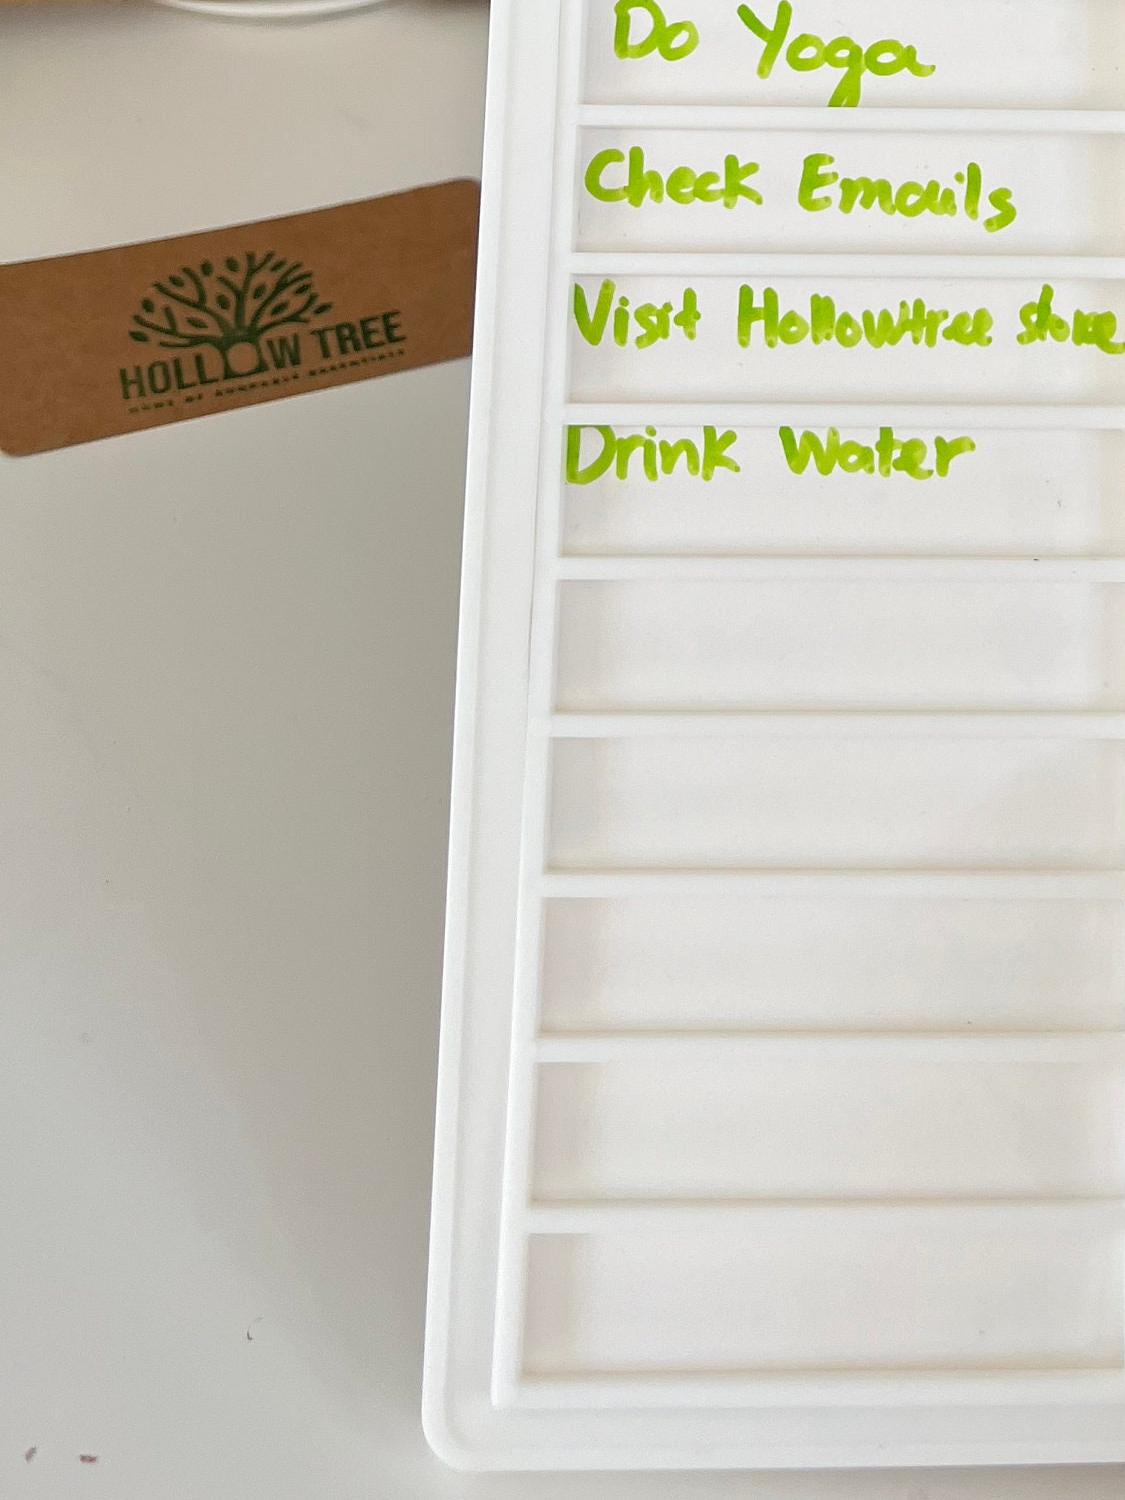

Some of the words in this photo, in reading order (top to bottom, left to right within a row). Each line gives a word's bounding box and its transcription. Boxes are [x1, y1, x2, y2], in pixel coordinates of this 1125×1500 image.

[737, 1, 935, 108] Yoga
[585, 147, 762, 209] Check
[798, 154, 1016, 232] Emails
[309, 309, 407, 360] TREE
[573, 280, 701, 349] Visit
[738, 285, 992, 348] Hollowtree
[566, 425, 740, 485] Drink
[779, 427, 975, 480] Water
